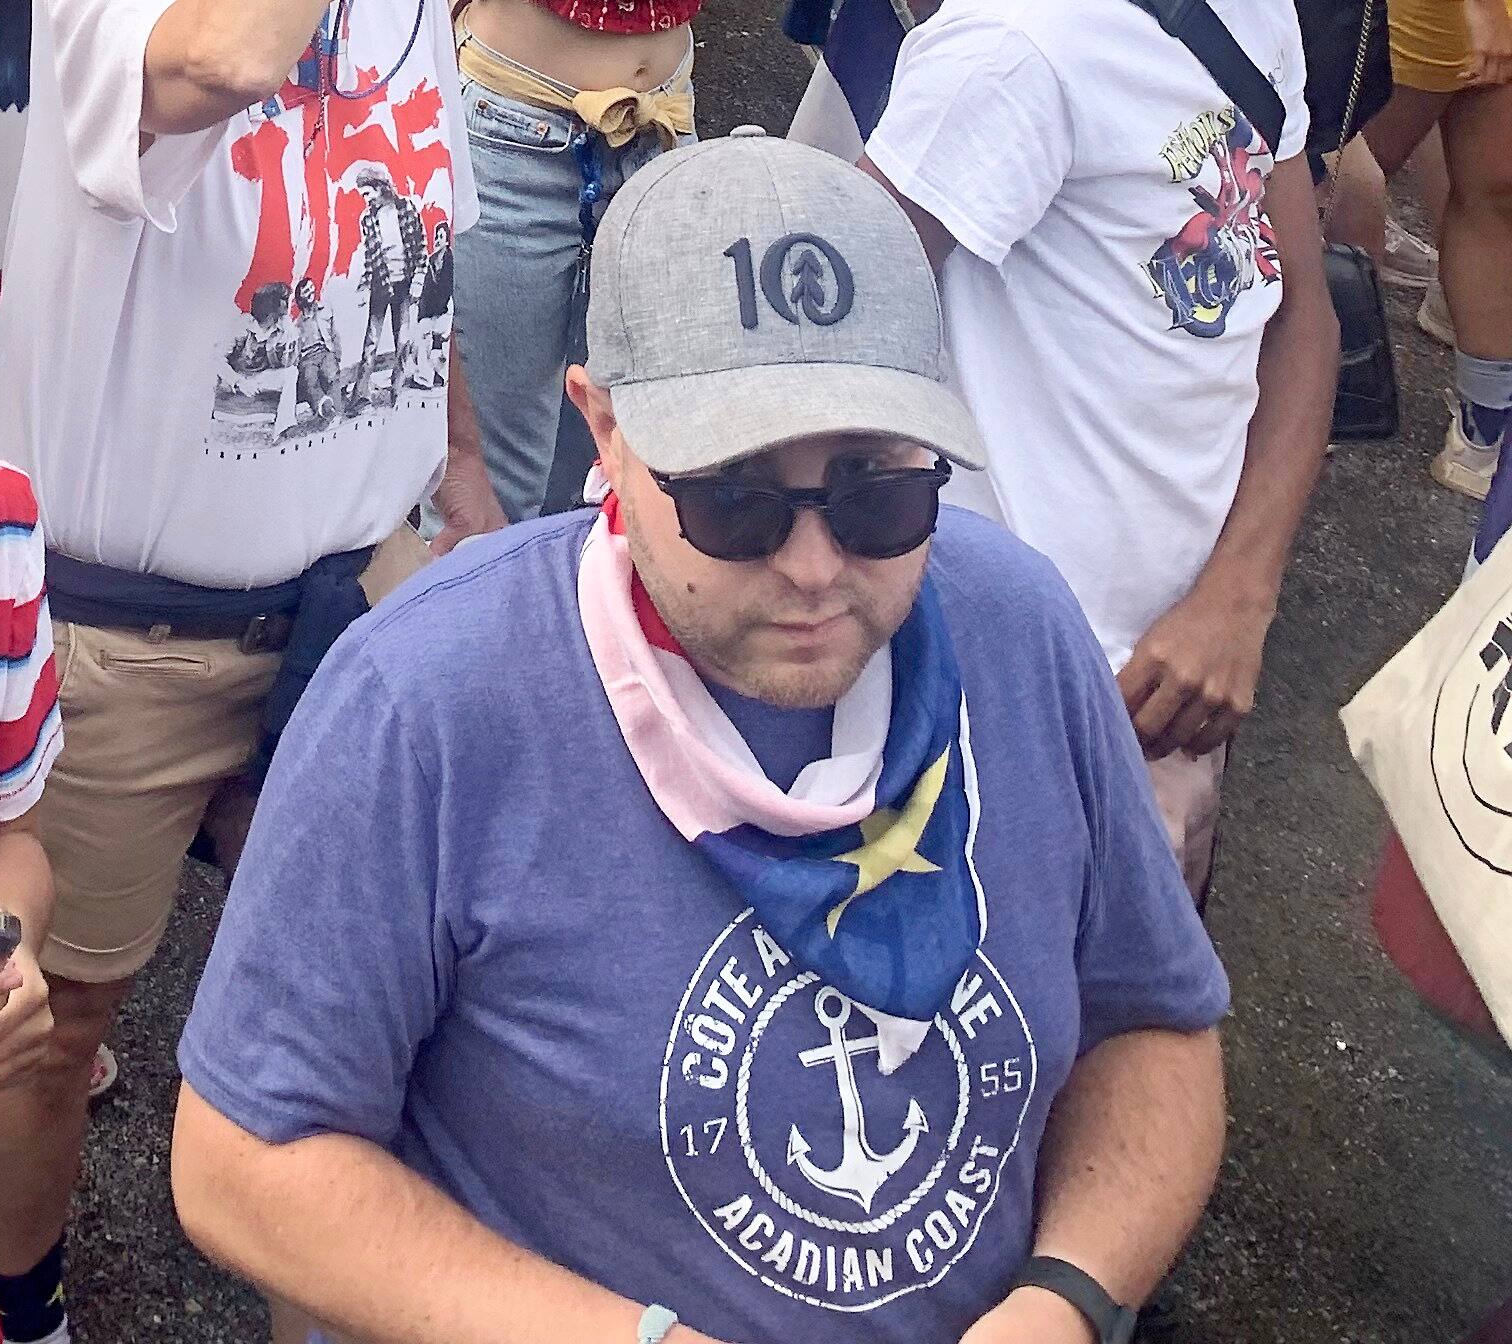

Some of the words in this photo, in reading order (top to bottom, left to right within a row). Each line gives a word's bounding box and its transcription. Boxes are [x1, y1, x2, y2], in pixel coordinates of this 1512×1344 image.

[723, 231, 855, 331] 10
[681, 956, 765, 1090] CÔTE
[679, 1116, 729, 1157] 17
[980, 1056, 1023, 1098] 55
[712, 1192, 895, 1293] ACADIAN
[904, 1134, 1000, 1276] COAST
